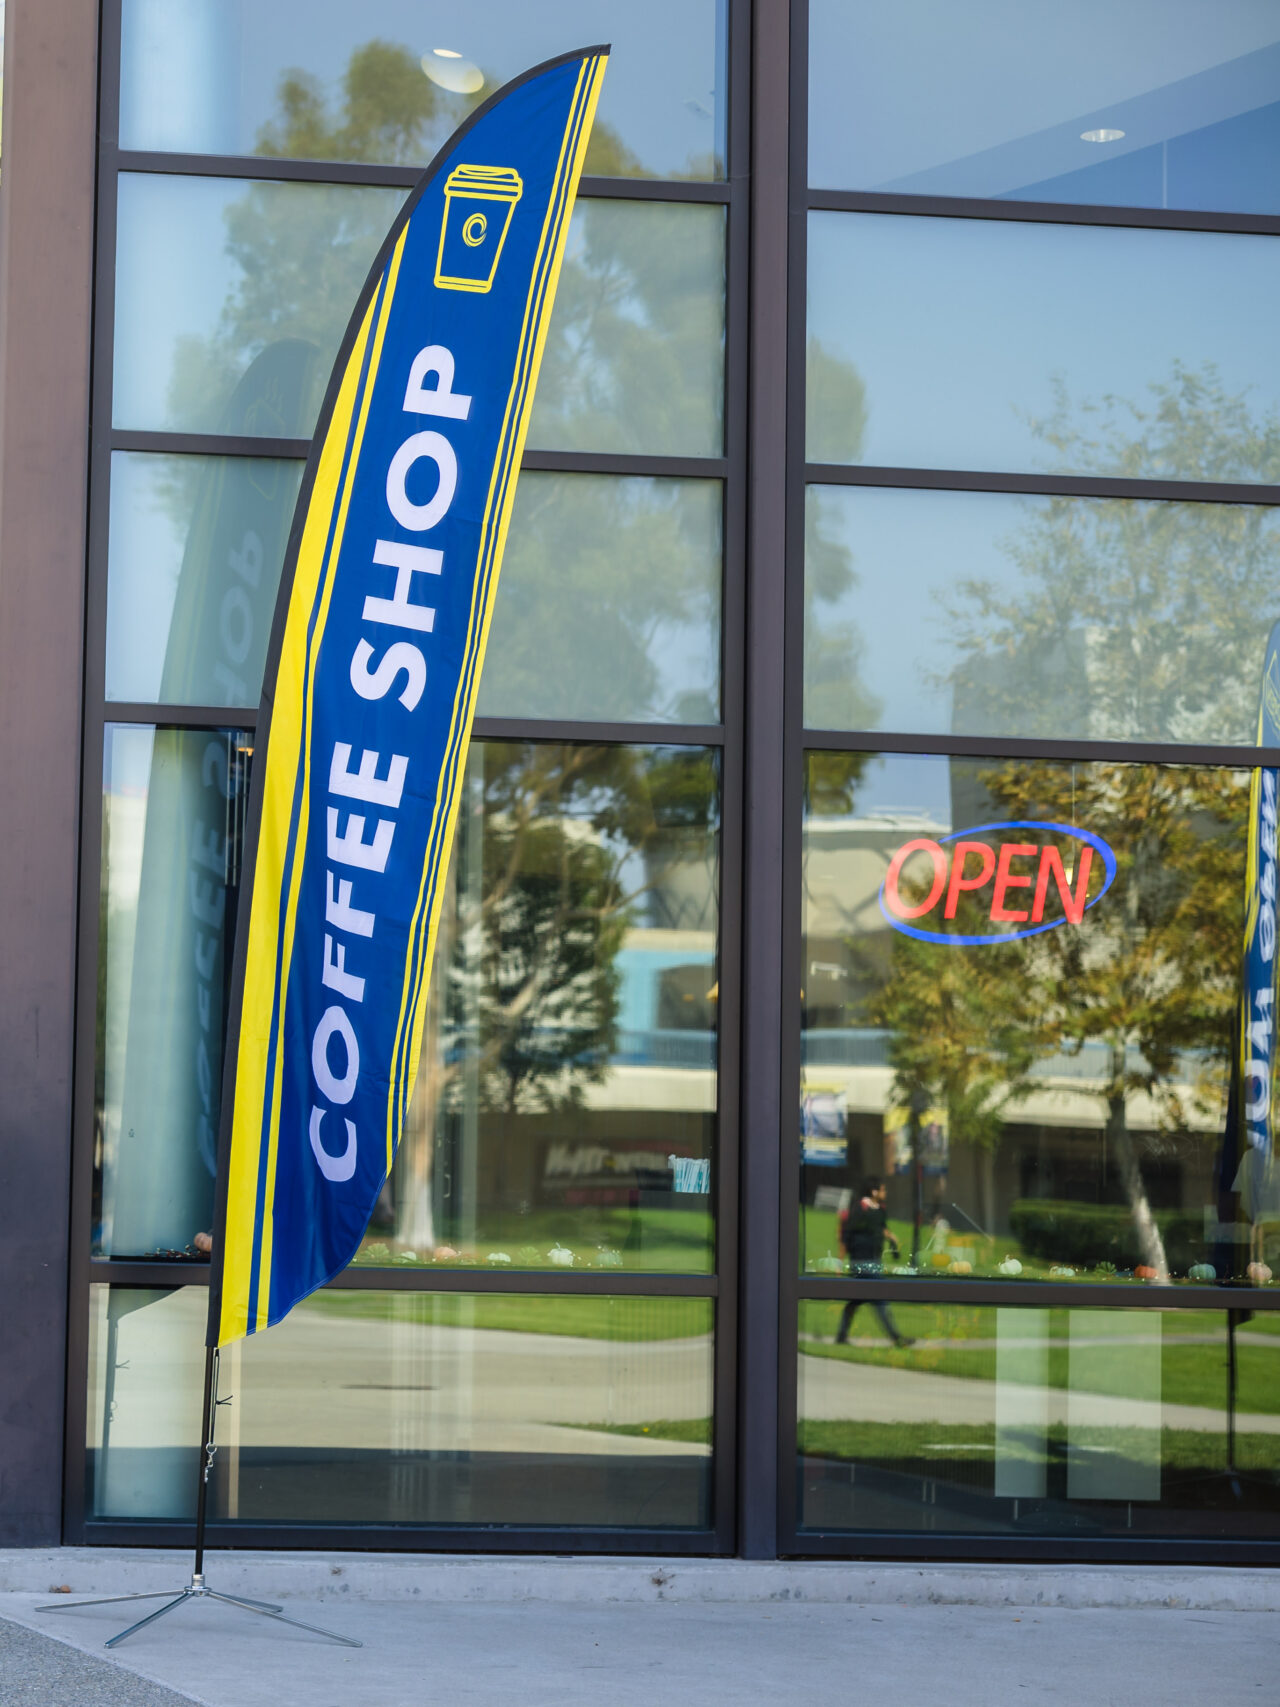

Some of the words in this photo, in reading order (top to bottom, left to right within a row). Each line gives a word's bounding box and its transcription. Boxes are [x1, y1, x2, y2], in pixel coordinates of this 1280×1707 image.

[349, 344, 475, 712] SHOP
[309, 740, 409, 1182] COFFEE
[885, 838, 1093, 924] OPEN
